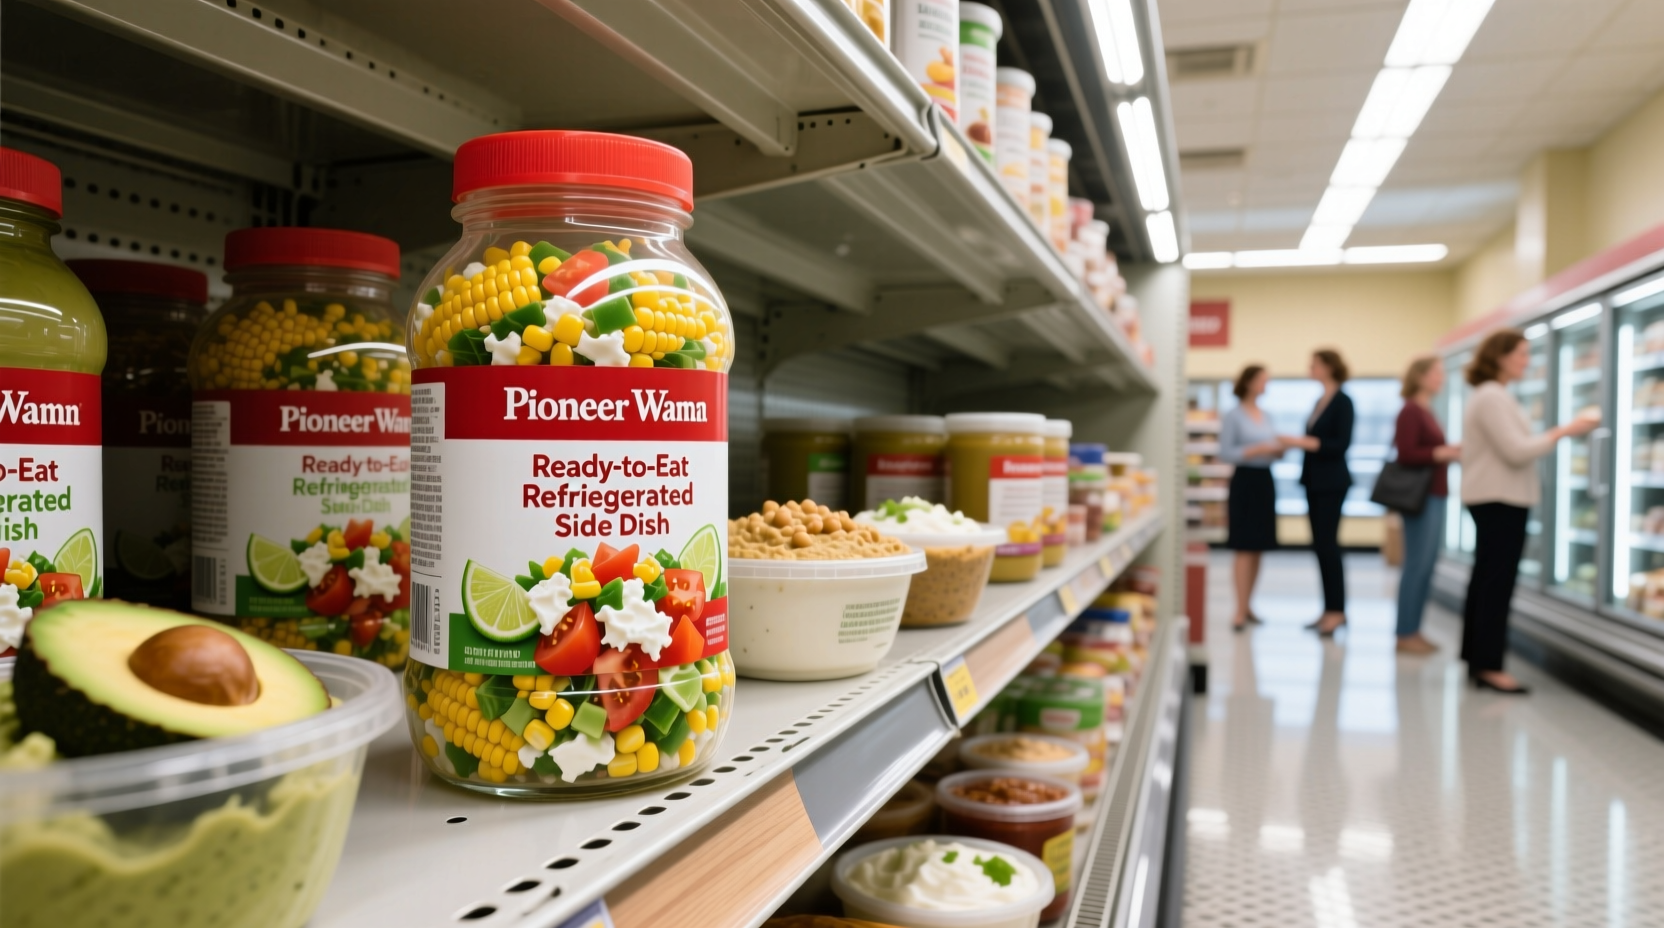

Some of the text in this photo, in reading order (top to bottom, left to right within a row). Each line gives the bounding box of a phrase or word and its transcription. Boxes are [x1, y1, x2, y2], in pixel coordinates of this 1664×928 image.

[503, 387, 630, 421] Pioneer
[138, 410, 191, 435] Pion
[279, 405, 374, 433] Pioneer
[533, 453, 689, 483] Ready-to-Eat
[522, 481, 693, 514] Refriegerated
[0, 516, 38, 541] ish
[554, 511, 670, 538] Side Dish
